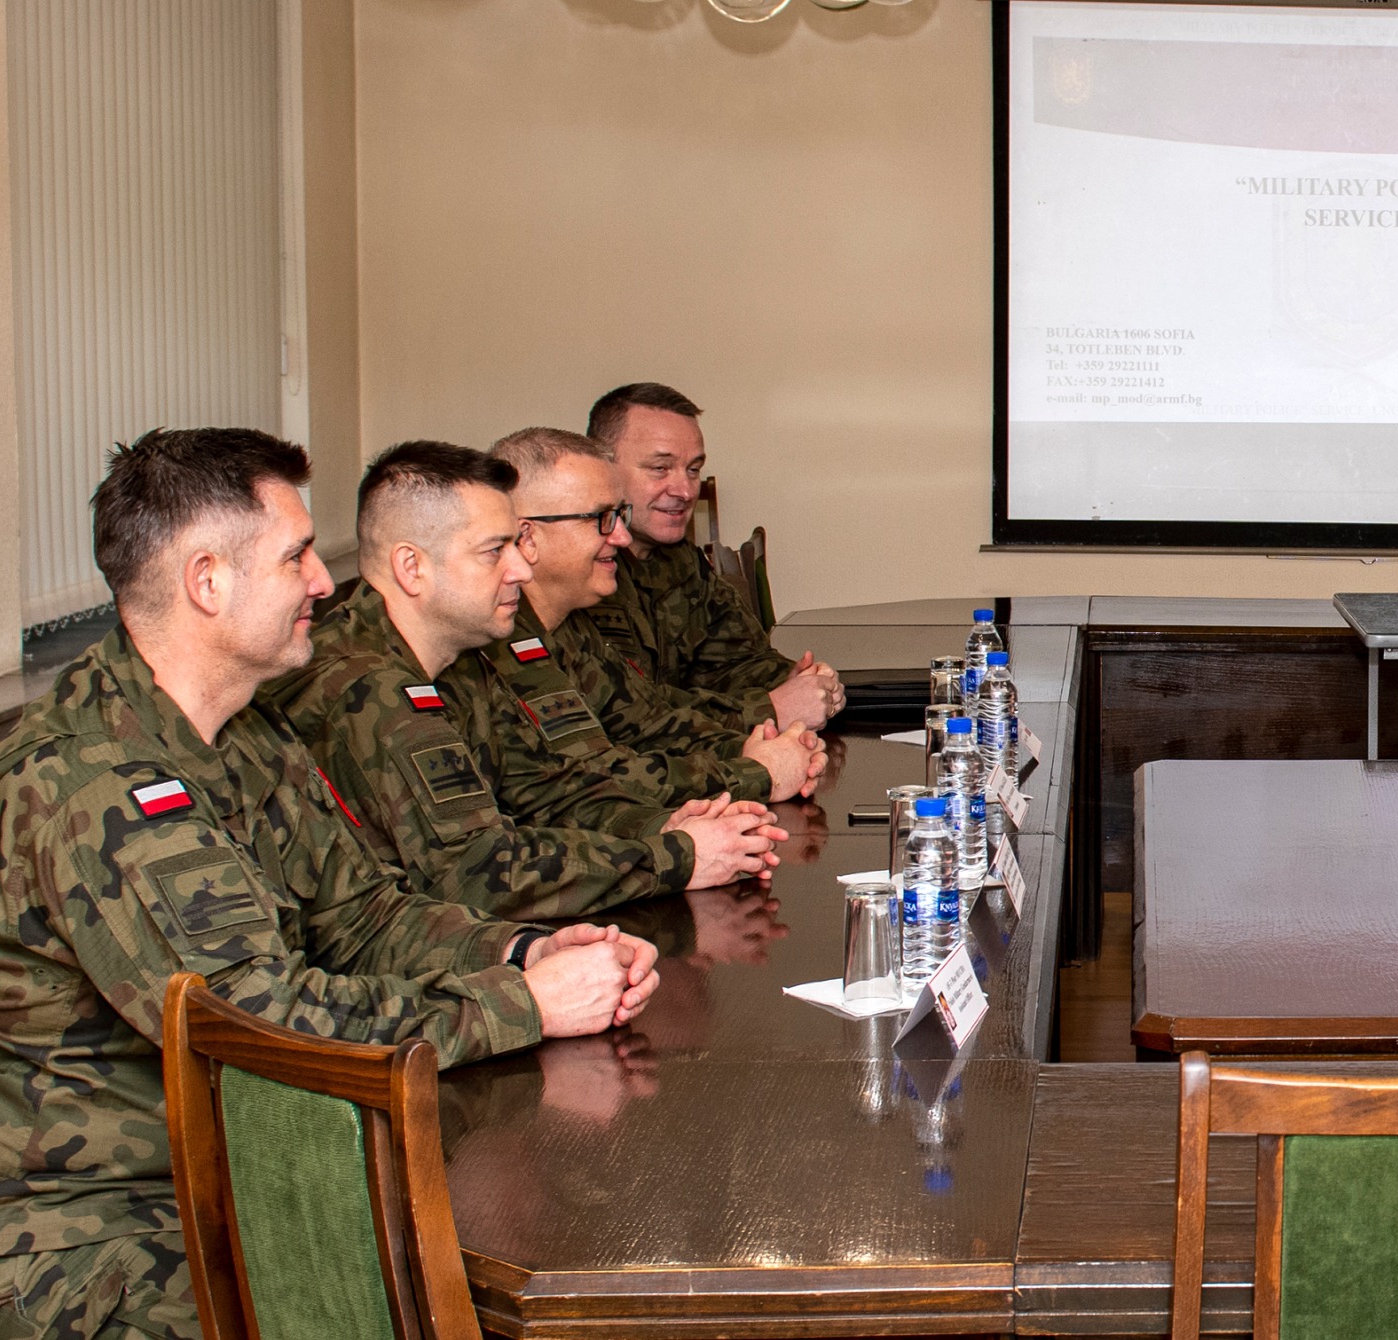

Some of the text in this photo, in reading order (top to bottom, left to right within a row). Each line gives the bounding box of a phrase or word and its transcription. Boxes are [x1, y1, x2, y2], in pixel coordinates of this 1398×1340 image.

[1046, 327, 1196, 340] BULGARIA 1606 SOFIA
[1068, 343, 1142, 355] TOTLEBEN
[1076, 360, 1105, 370] +359
[1108, 360, 1159, 372] 29221111
[1110, 376, 1165, 388] 29221412
[1091, 393, 1203, 407] mp_mod@armf.bg
